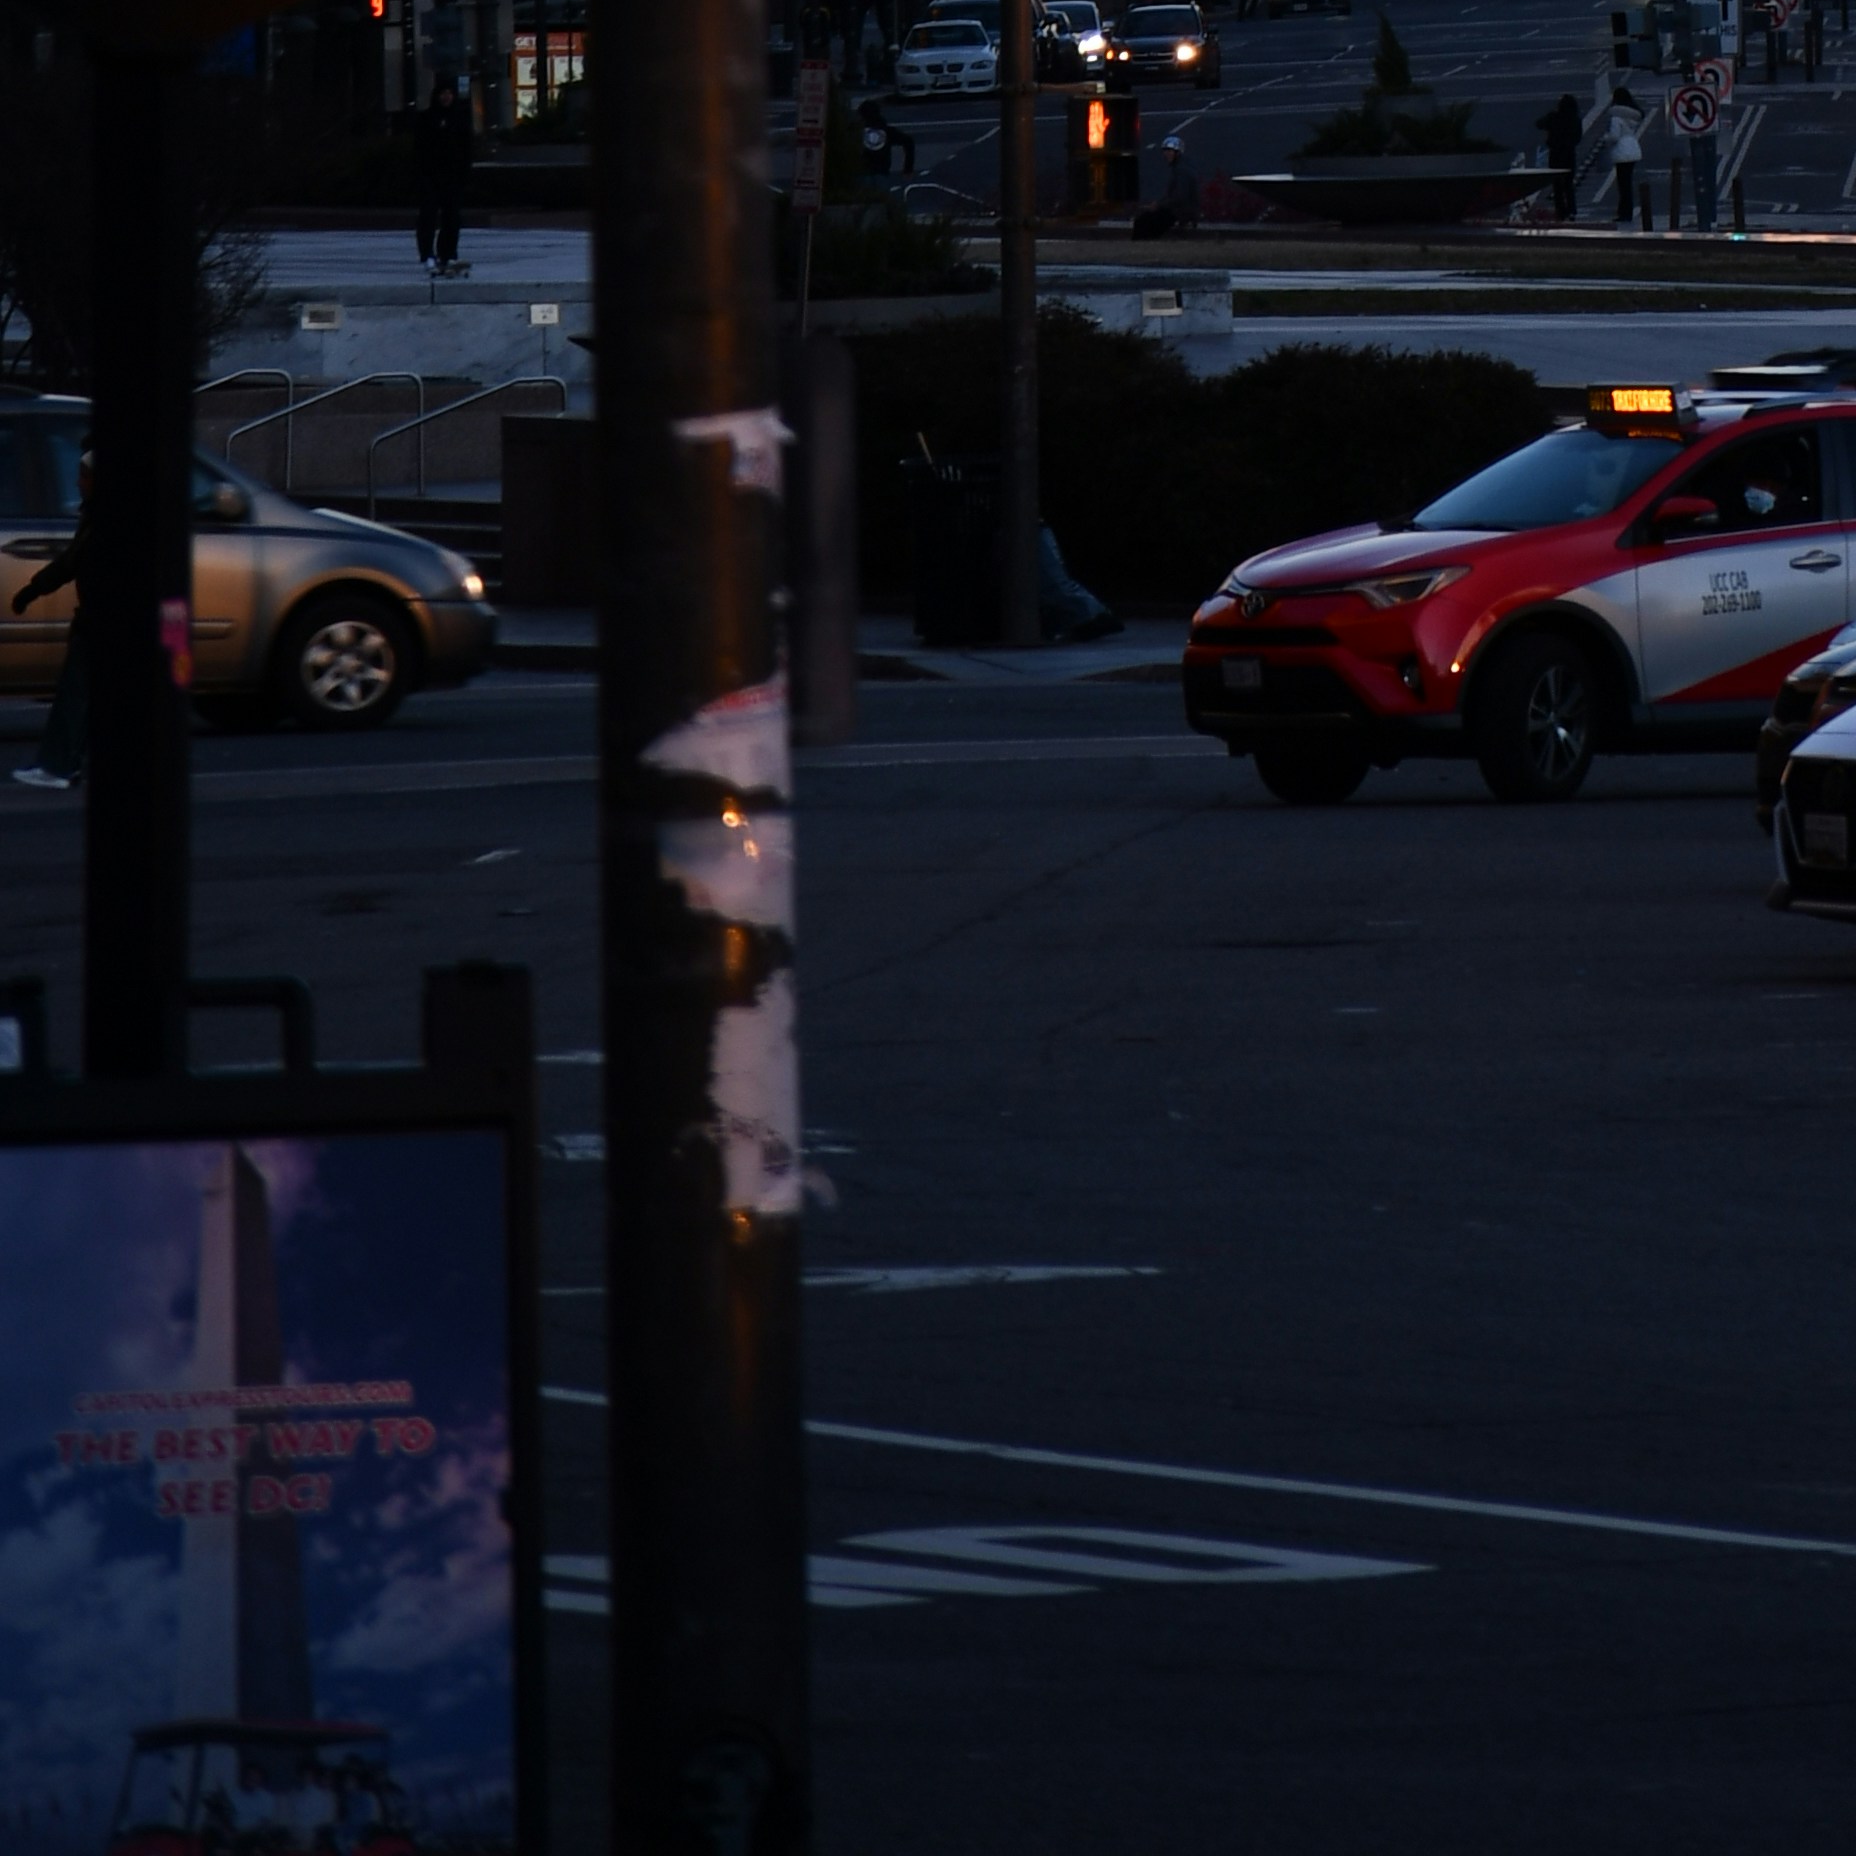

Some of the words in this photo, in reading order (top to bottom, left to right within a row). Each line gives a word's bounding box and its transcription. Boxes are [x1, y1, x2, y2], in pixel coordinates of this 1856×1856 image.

[1709, 573, 1729, 592] UCC
[1730, 571, 1748, 591] CAB
[56, 1430, 139, 1464] THE
[154, 1422, 259, 1462] BEST
[266, 1419, 364, 1460] WAY
[370, 1416, 437, 1458] TO
[156, 1480, 236, 1519] SEE
[247, 1473, 333, 1517] DC!
